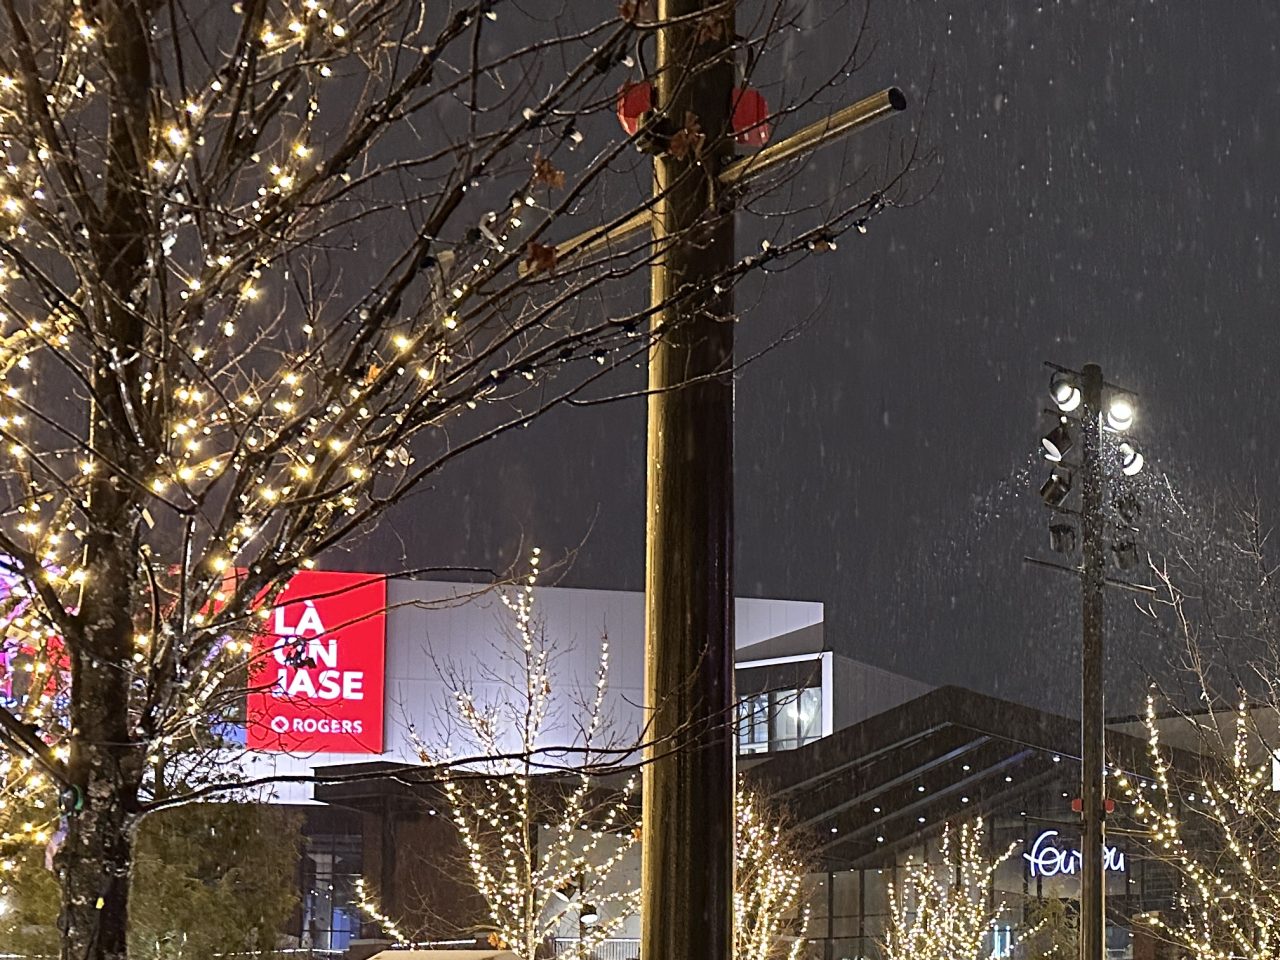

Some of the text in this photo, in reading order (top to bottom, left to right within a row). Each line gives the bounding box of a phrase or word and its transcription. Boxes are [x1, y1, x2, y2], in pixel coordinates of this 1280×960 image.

[274, 600, 326, 636] LÀ
[273, 637, 337, 667] ON
[271, 669, 364, 700] JASE
[292, 718, 363, 734] ROGERS
